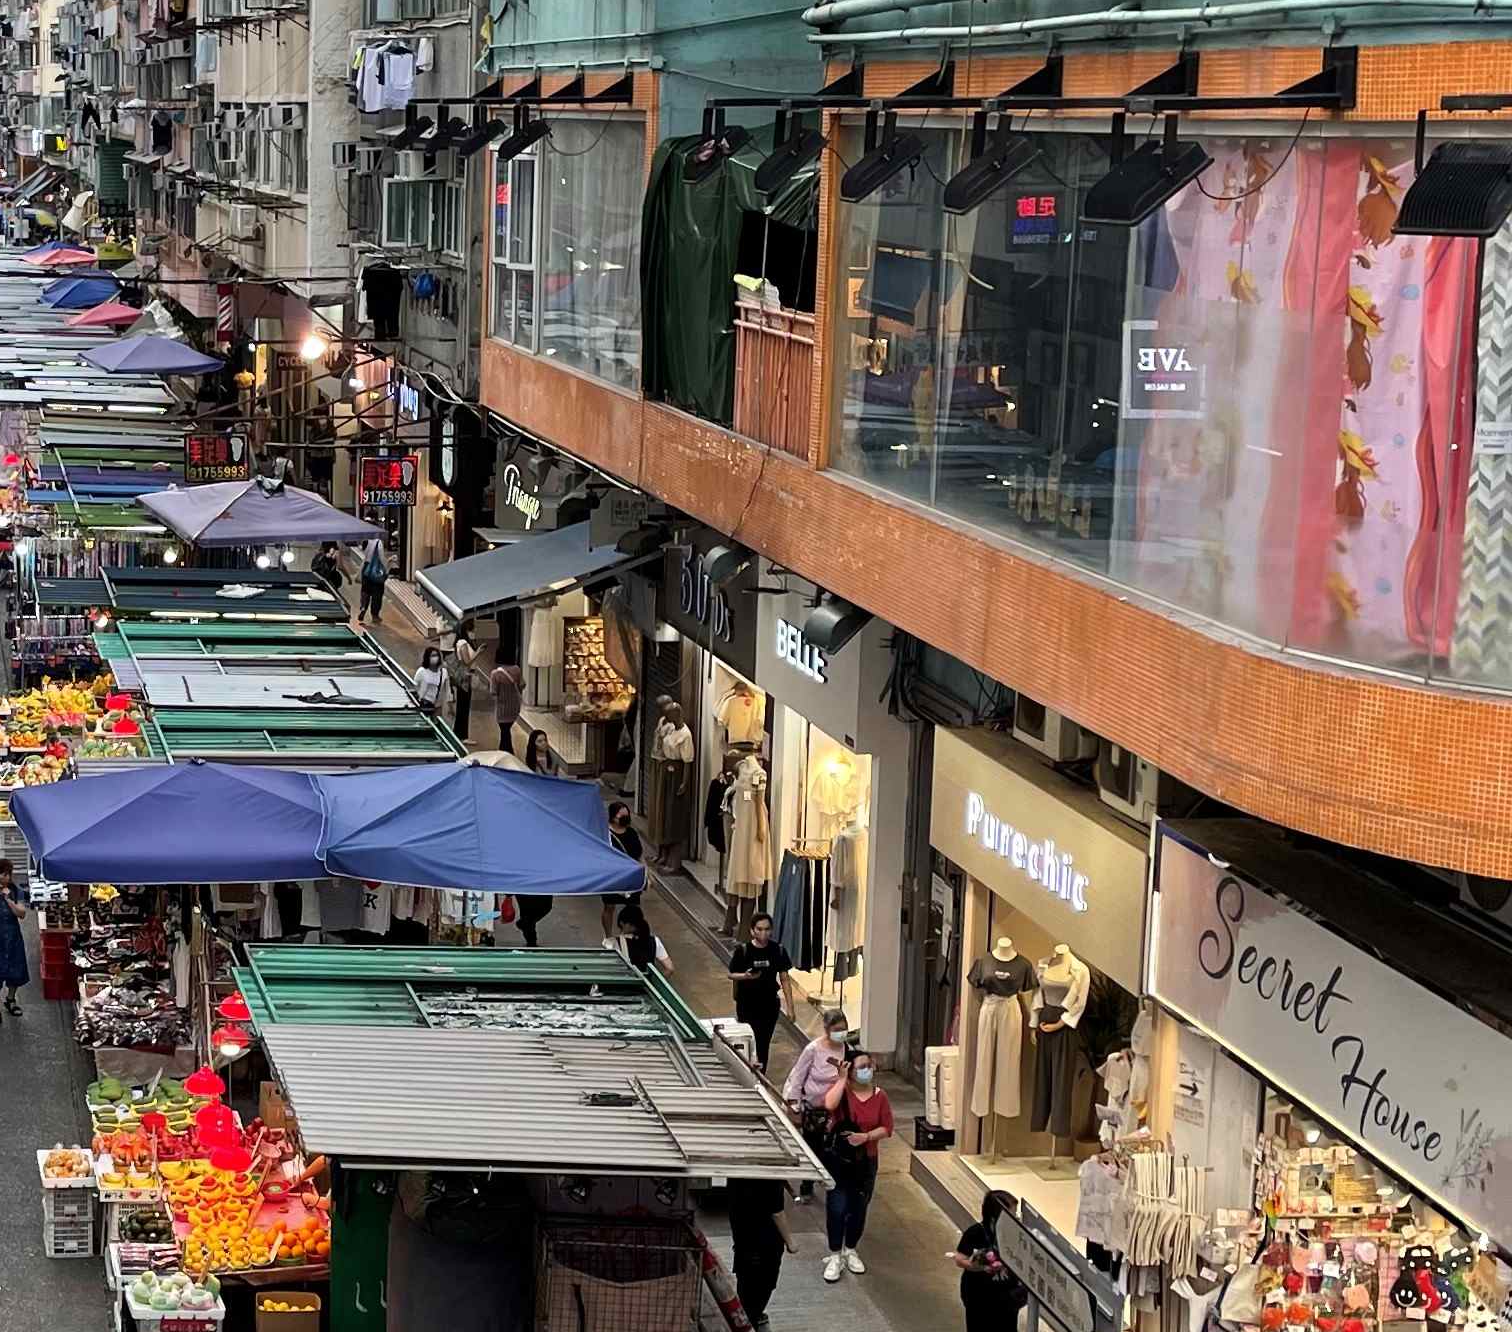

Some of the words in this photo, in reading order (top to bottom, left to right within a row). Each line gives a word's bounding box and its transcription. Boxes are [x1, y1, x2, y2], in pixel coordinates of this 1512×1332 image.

[190, 465, 245, 478] 91755993
[1198, 876, 1352, 1034] Secret
[1331, 1035, 1441, 1161] House
